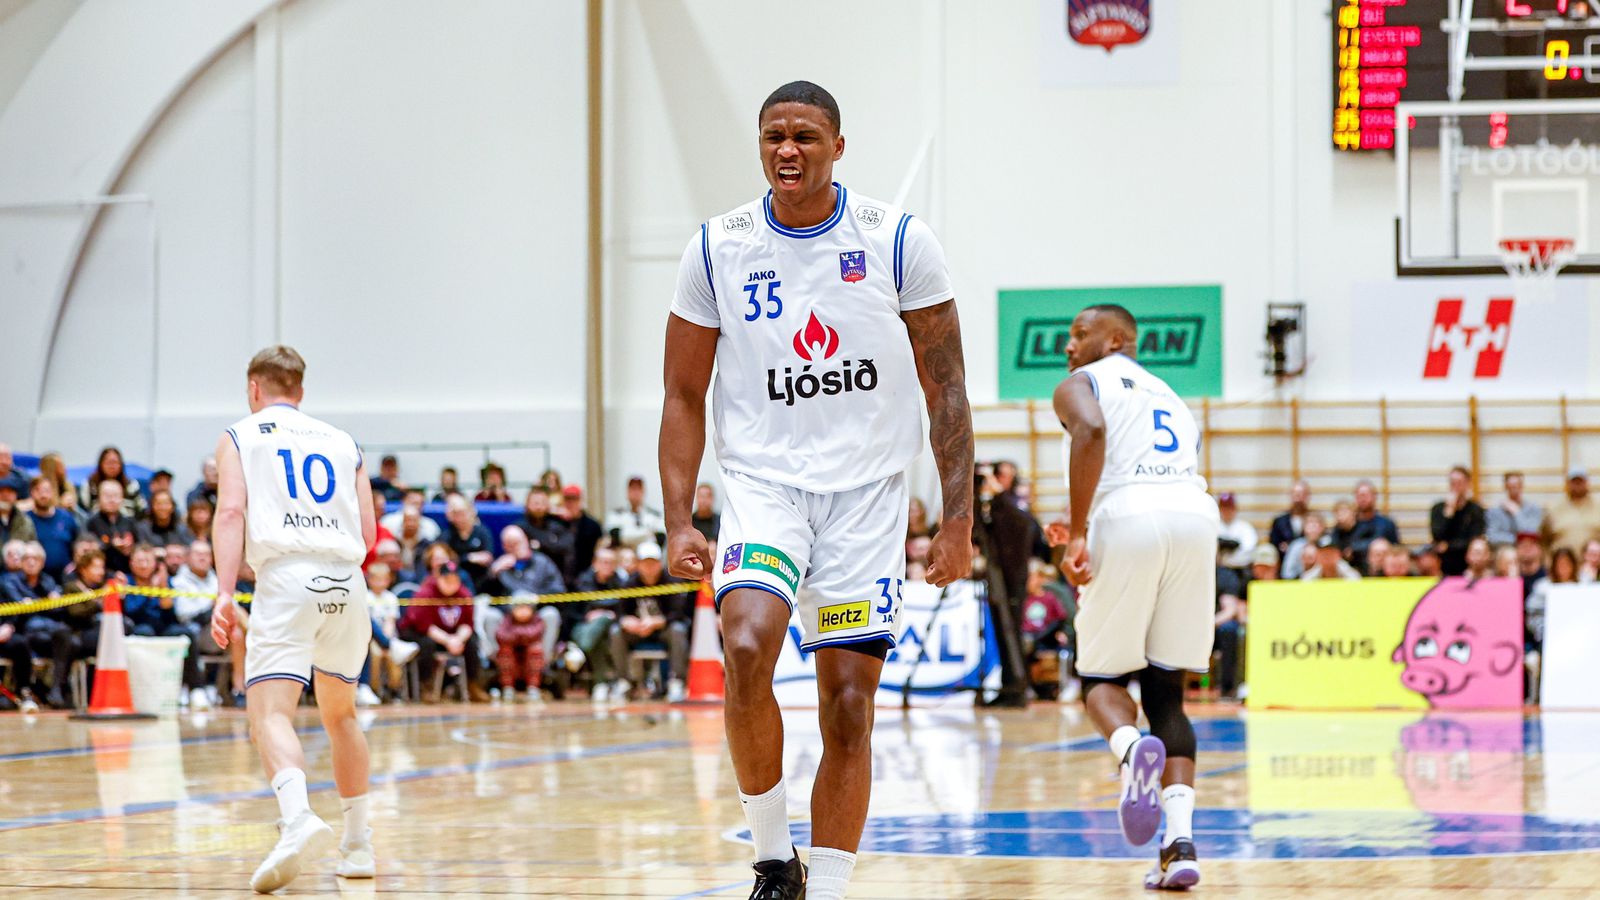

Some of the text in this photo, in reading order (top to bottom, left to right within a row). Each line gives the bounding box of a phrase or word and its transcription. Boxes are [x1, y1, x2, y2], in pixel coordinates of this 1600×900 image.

[726, 221, 751, 229] LAND
[748, 270, 776, 281] JAKO
[743, 281, 783, 321] 35
[767, 359, 878, 406] Ljósið
[1152, 409, 1179, 453] 5
[277, 448, 336, 503] 10
[748, 551, 798, 585] SUBWAY
[821, 608, 863, 627] Hertz
[1271, 631, 1376, 660] BÓNUS
